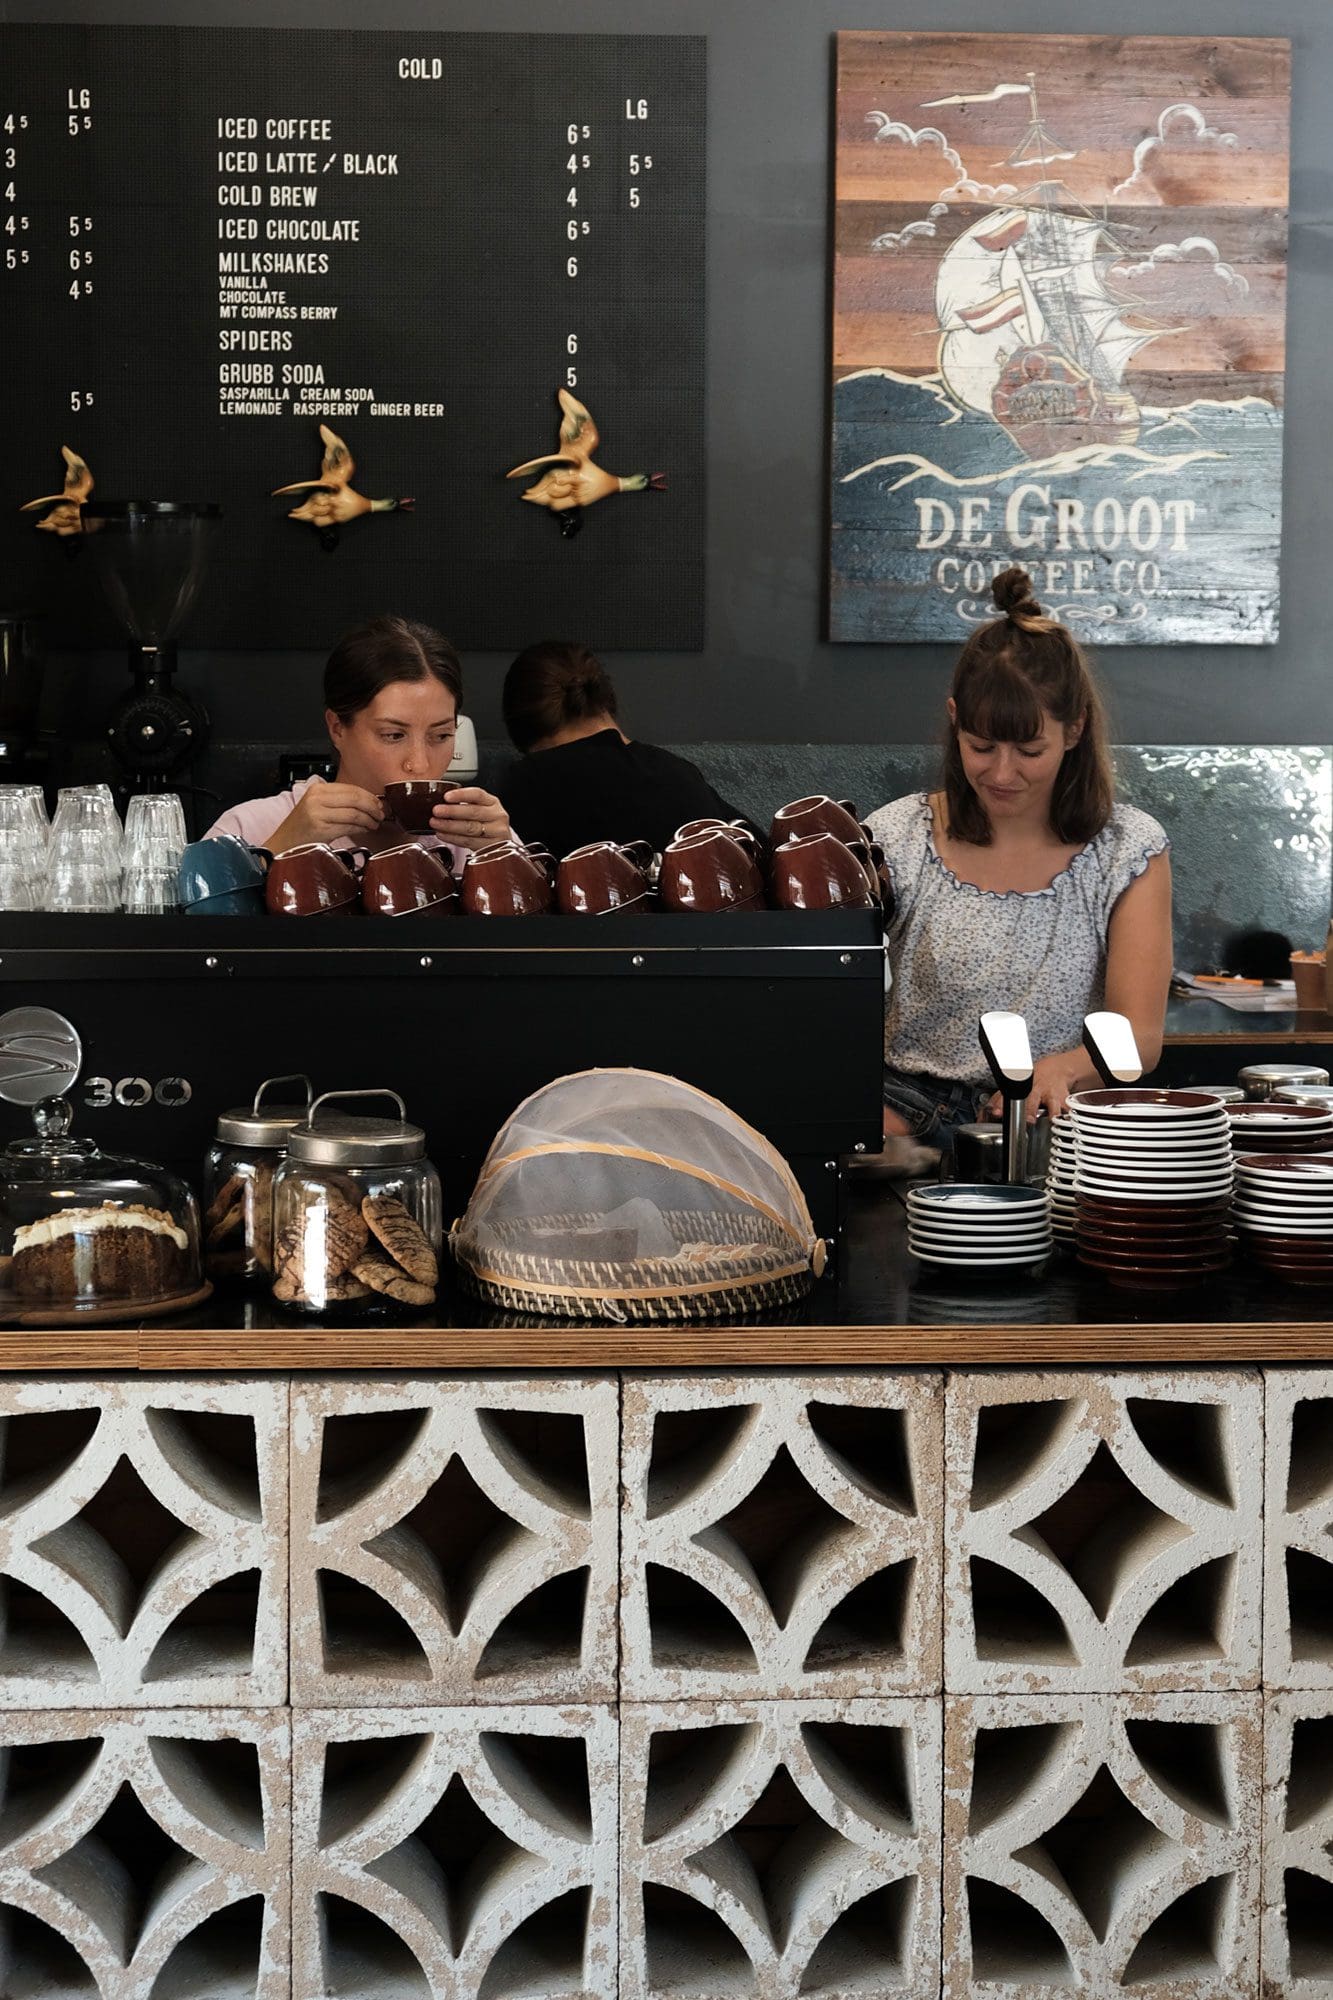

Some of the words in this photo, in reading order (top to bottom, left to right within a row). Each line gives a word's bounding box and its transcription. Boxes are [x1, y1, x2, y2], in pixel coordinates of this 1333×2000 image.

[398, 57, 443, 80] COLD
[68, 88, 90, 109] LG
[625, 98, 648, 120] LG
[218, 117, 258, 139] ICED
[265, 118, 332, 141] COFFEE
[5, 147, 16, 169] 3
[218, 151, 258, 173] ICED
[266, 152, 318, 174] LATTE
[343, 153, 399, 175] BLACK
[5, 181, 16, 202] 4
[218, 184, 262, 207] COLD
[269, 185, 318, 207] BREW
[566, 186, 578, 208] 4
[629, 187, 641, 209] 5
[218, 218, 258, 240] ICED
[266, 219, 360, 242] CHOCOLATE
[218, 252, 329, 274] MILKSHAKES
[567, 256, 578, 278] 6
[218, 275, 268, 290] VANILLA
[218, 290, 286, 305] CHOCOLATE
[219, 305, 238, 319] MT
[241, 305, 298, 320] COMPASS
[300, 306, 338, 320] BERRY
[219, 330, 293, 351] SPIDERS
[566, 333, 578, 355] 6
[219, 363, 274, 385] GRUBB
[282, 363, 325, 385] SODA
[567, 366, 577, 388] 5
[219, 386, 290, 401] SASPARILLA
[300, 387, 341, 401] CREAM
[344, 388, 375, 402] SODA
[219, 401, 282, 416] LEMONADE
[293, 402, 360, 416] RASPBERRY
[370, 402, 412, 417] GINGER
[414, 403, 445, 417] BEER
[914, 497, 992, 550] DE
[1005, 484, 1196, 552] GROOT
[83, 1076, 193, 1108] 300
